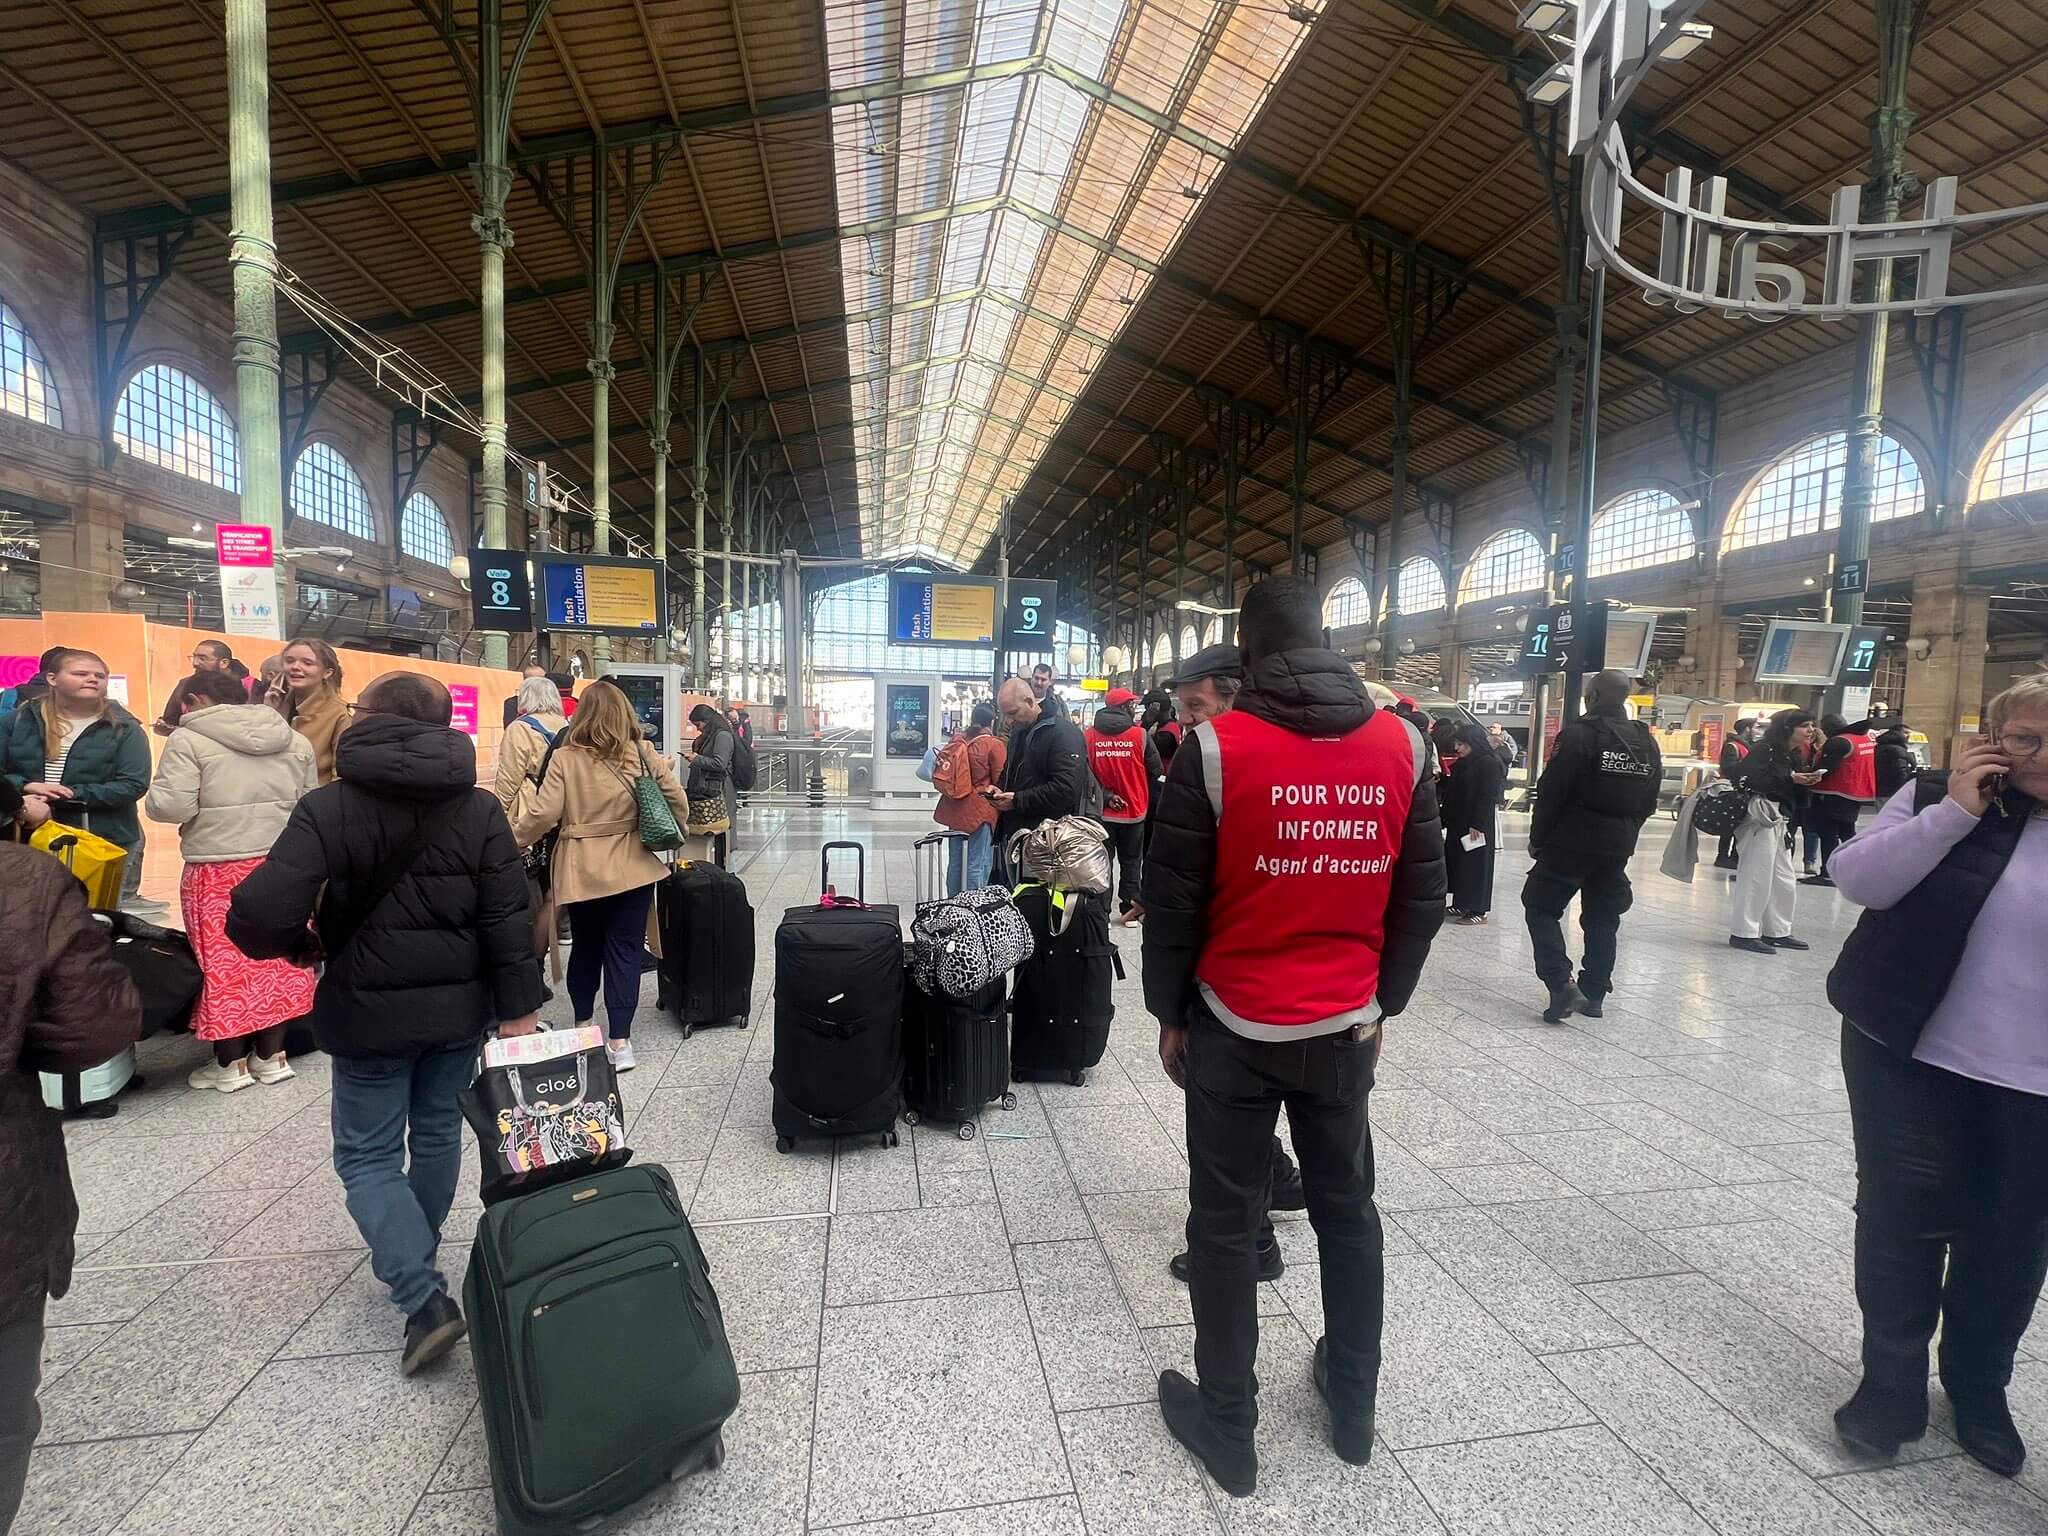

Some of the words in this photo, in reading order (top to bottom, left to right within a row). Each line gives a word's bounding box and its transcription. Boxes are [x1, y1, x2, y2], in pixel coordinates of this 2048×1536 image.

[529, 482, 536, 502] 8
[1840, 571, 1860, 587] 11
[491, 581, 510, 605] 8
[573, 567, 586, 624] circulation
[563, 597, 575, 623] flash
[921, 585, 932, 639] circulation
[1022, 607, 1038, 630] 9
[911, 613, 921, 638] flash
[1853, 650, 1874, 668] 11
[1271, 785, 1328, 806] POUR
[1335, 784, 1386, 806] VOUS
[1278, 820, 1378, 841] INFORMER
[1254, 854, 1308, 876] Agent
[1312, 854, 1391, 875] d'accueil
[536, 1074, 577, 1094] cloé
